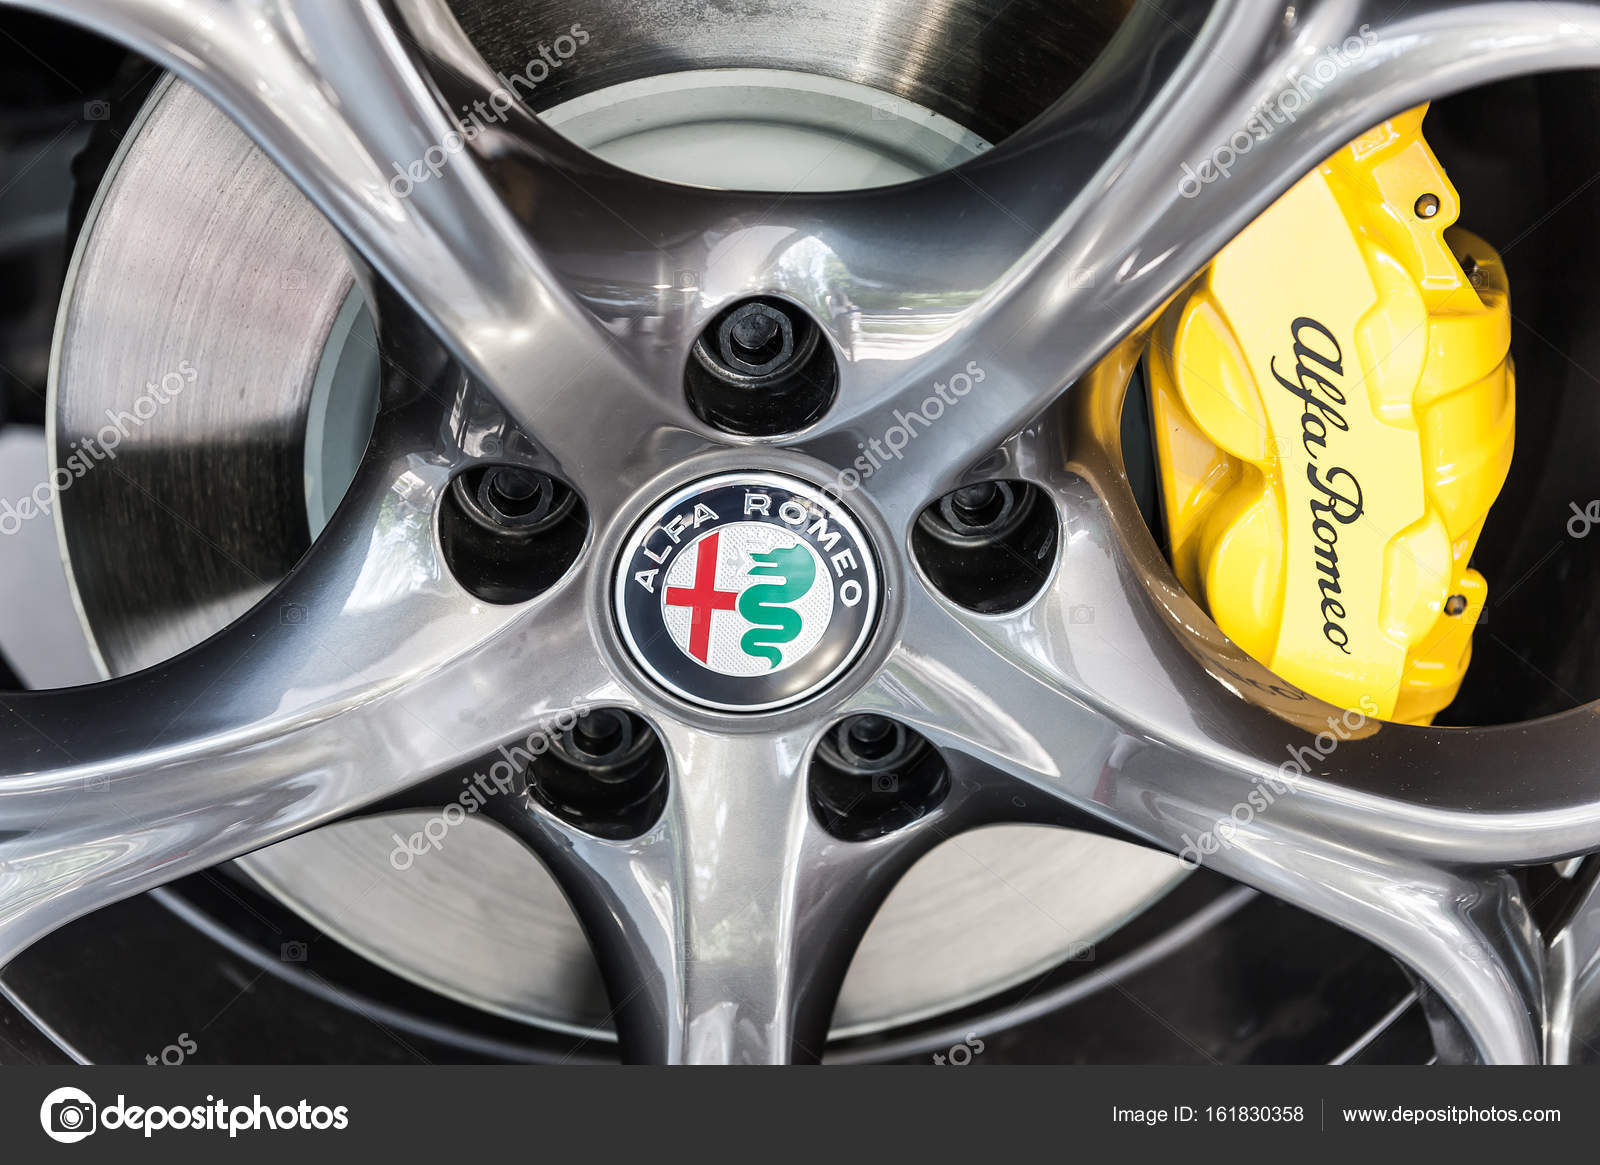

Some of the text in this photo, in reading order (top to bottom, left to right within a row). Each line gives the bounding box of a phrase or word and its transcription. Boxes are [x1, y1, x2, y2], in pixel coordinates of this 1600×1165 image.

[634, 491, 863, 608] ALFA ROMEO
[1271, 317, 1365, 655] Alfa Romeo
